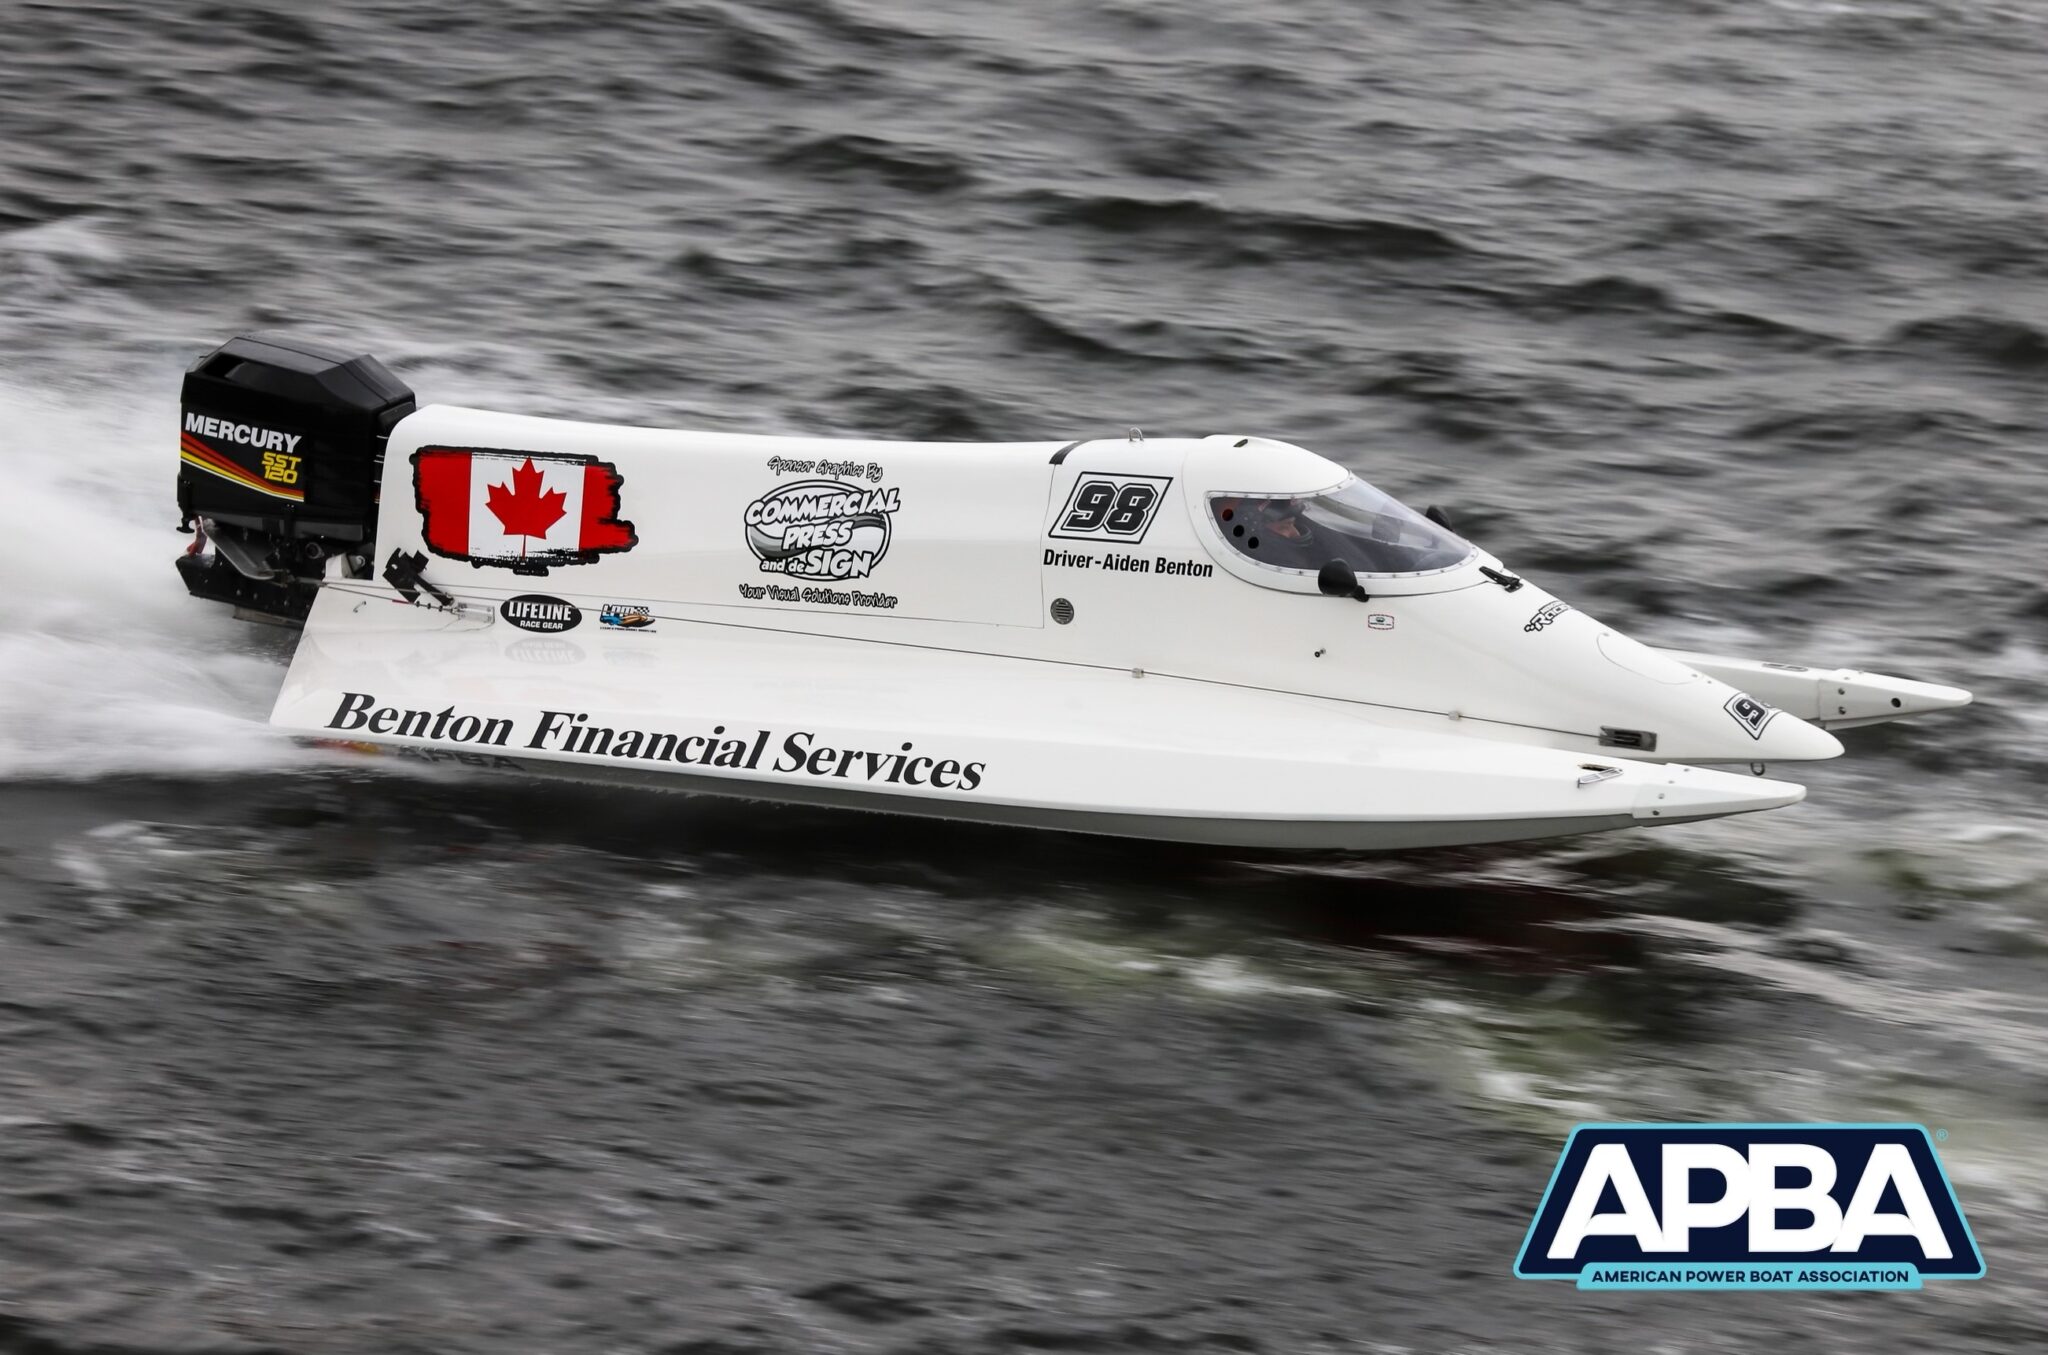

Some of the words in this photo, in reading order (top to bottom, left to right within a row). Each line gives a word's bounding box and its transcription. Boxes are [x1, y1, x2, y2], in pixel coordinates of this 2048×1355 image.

[185, 413, 302, 453] MERCURY
[262, 452, 302, 469] SST
[767, 455, 815, 476] Sponsor
[816, 460, 864, 479] Graphics
[866, 463, 883, 482] By
[264, 468, 298, 484] 120
[745, 487, 901, 526] COMMERCIAL
[1060, 480, 1158, 536] 98
[782, 520, 855, 550] PRESS
[760, 558, 786, 572] and
[1155, 557, 1213, 578] Benton
[739, 584, 766, 598] Your
[767, 585, 800, 601] Visual
[801, 587, 851, 605] Solutions
[852, 591, 898, 608] Provider
[508, 601, 572, 621] LIFELINE
[520, 620, 541, 629] RACE
[542, 622, 563, 630] GEAR
[324, 692, 514, 746] Benton
[521, 710, 772, 770] Financial
[773, 731, 987, 791] Services
